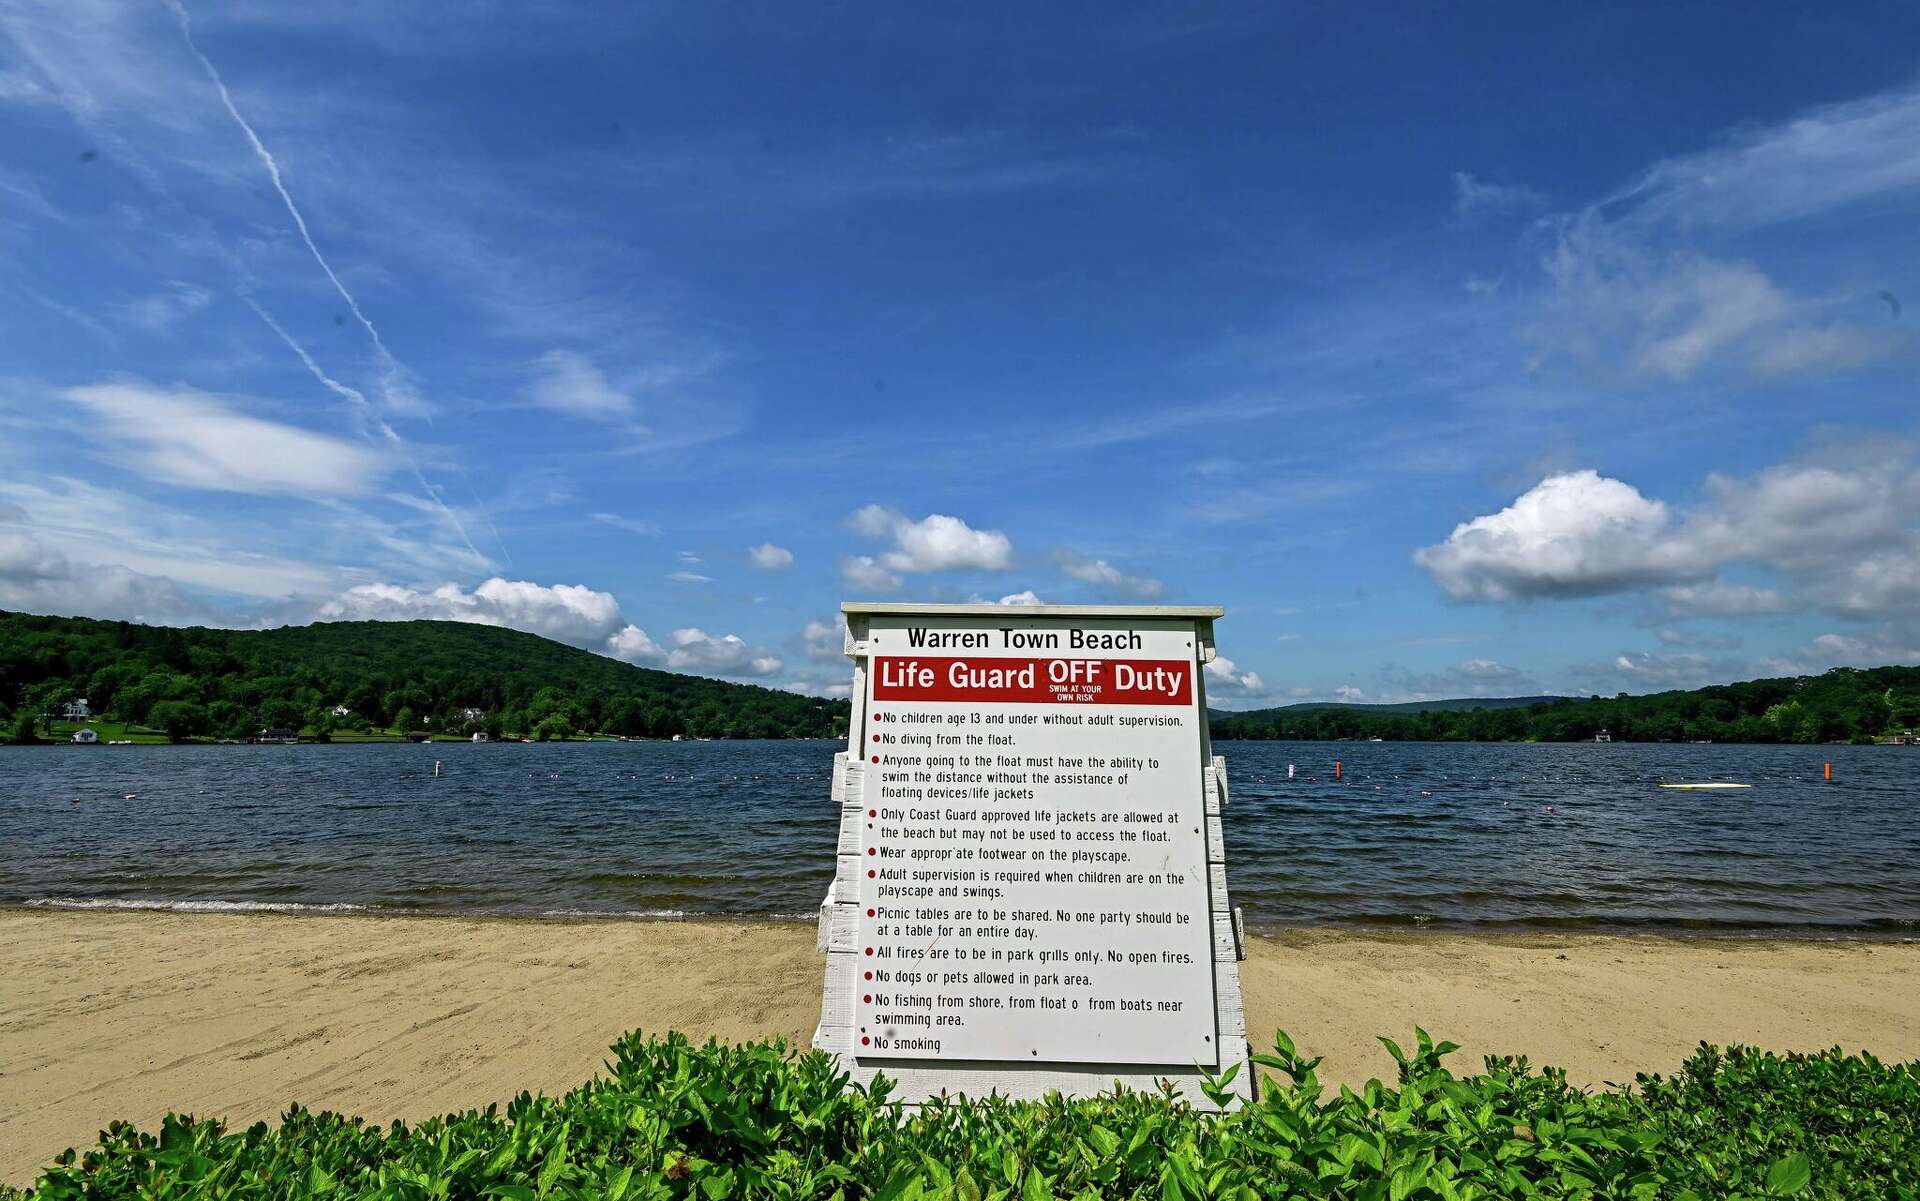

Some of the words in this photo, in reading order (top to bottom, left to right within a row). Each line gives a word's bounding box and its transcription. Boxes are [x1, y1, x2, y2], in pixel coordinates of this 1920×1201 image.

[907, 627, 989, 648] Warren
[999, 628, 1059, 649] Town
[1070, 628, 1141, 650] Beach
[882, 661, 934, 688] Life
[948, 662, 1034, 688] Guard
[1048, 660, 1102, 683] OFF
[1115, 664, 1182, 696] Duty
[1049, 684, 1068, 692] SWIM
[1082, 685, 1102, 693] YOUR
[1057, 693, 1074, 701] OWN
[1076, 694, 1094, 702] RISK
[883, 712, 896, 723] No
[901, 712, 942, 724] children
[947, 714, 966, 727] age
[970, 712, 980, 724] 13
[985, 714, 1004, 724] and
[1008, 714, 1038, 724] under
[1043, 714, 1082, 725] without
[1088, 714, 1114, 726] adult
[1119, 715, 1183, 728] supervision.
[882, 733, 896, 744] No
[901, 733, 932, 748] diving
[936, 734, 961, 744] from
[966, 734, 983, 745] the
[988, 734, 1016, 745] float.
[882, 754, 922, 768] Anyone
[926, 755, 954, 770] going
[959, 756, 970, 766] to
[975, 756, 992, 766] the
[997, 755, 1021, 767] float
[1026, 756, 1053, 767] must
[1058, 756, 1083, 768] have
[1088, 757, 1105, 768] the
[1110, 757, 1144, 771] ability
[1148, 758, 1159, 769] to
[882, 771, 909, 782] swim
[914, 771, 931, 782] the
[936, 771, 982, 783] distance
[987, 772, 1027, 784] without
[1032, 773, 1049, 784] the
[1054, 773, 1113, 784] assistance
[1118, 773, 1128, 785] of
[882, 786, 922, 802] floating
[927, 787, 989, 798] devices/life
[994, 788, 1034, 802] jackets
[881, 808, 905, 822] Only
[910, 808, 940, 820] Coast
[946, 808, 976, 821] Guard
[981, 810, 1030, 823] approved
[1035, 810, 1051, 822] life
[1056, 810, 1096, 825] jackets
[1101, 813, 1118, 822] are
[1124, 812, 1163, 823] allowed
[1168, 812, 1178, 824] at
[881, 827, 898, 838] the
[904, 827, 935, 838] beach
[940, 828, 957, 839] but
[962, 830, 985, 842] may
[990, 828, 1007, 840] not
[1012, 829, 1025, 840] be
[1030, 829, 1056, 840] used
[1060, 829, 1072, 840] to
[1076, 832, 1114, 842] access
[1120, 830, 1136, 842] the
[1142, 830, 1170, 842] float.
[880, 846, 906, 858] Wear
[910, 848, 974, 861] approprate
[979, 848, 1027, 860] footwear
[1032, 851, 1044, 860] on
[1050, 849, 1067, 861] the
[1072, 850, 1130, 864] playscape.
[879, 868, 907, 880] Adult
[912, 869, 975, 883] supervision
[980, 869, 990, 881] is
[995, 870, 1040, 884] required
[1045, 871, 1073, 882] when
[1078, 871, 1121, 884] children
[1126, 874, 1144, 884] are
[1148, 874, 1162, 884] on
[1166, 873, 1184, 884] the
[878, 884, 934, 899] playscape
[938, 885, 958, 897] and
[963, 885, 1004, 901] swings.
[878, 907, 910, 919] Picnic
[916, 908, 949, 920] tables
[954, 910, 972, 920] are
[977, 908, 988, 920] to
[993, 909, 1006, 921] be
[1012, 909, 1052, 922] shared.
[1056, 910, 1070, 922] No
[1076, 912, 1095, 922] one
[1100, 911, 1131, 926] party
[1136, 912, 1172, 924] should
[1176, 912, 1190, 924] be
[877, 924, 888, 936] at
[894, 926, 900, 936] a
[905, 924, 933, 936] table
[938, 924, 954, 936] for
[958, 927, 972, 937] an
[977, 925, 1010, 938] entire
[1014, 926, 1038, 941] day.
[877, 946, 891, 958] All
[897, 946, 925, 958] fires
[930, 950, 949, 959] are
[955, 948, 967, 960] to
[972, 948, 986, 960] be
[992, 948, 1002, 960] in
[1008, 949, 1034, 963] park
[1039, 949, 1069, 964] grills
[1074, 950, 1103, 965] only.
[1108, 950, 1123, 962] No
[1128, 952, 1157, 966] open
[1162, 951, 1194, 964] fires.
[876, 970, 890, 982] No
[895, 970, 922, 986] dogs
[926, 973, 938, 983] or
[944, 971, 968, 986] pets
[974, 972, 1014, 984] allowed
[1020, 972, 1029, 984] in
[1034, 973, 1059, 987] park
[1064, 975, 1092, 986] area.
[875, 994, 890, 1006] No
[895, 994, 932, 1010] fishing
[938, 994, 964, 1007] from
[1009, 996, 1035, 1008] from
[1040, 996, 1066, 1009] float
[1089, 997, 1115, 1010] from
[1120, 998, 1152, 1011] boats
[1158, 1001, 1183, 1012] near
[875, 1012, 930, 1028] swimming
[936, 1015, 964, 1026] area.
[874, 1036, 888, 1049] No
[894, 1037, 940, 1053] smoking
